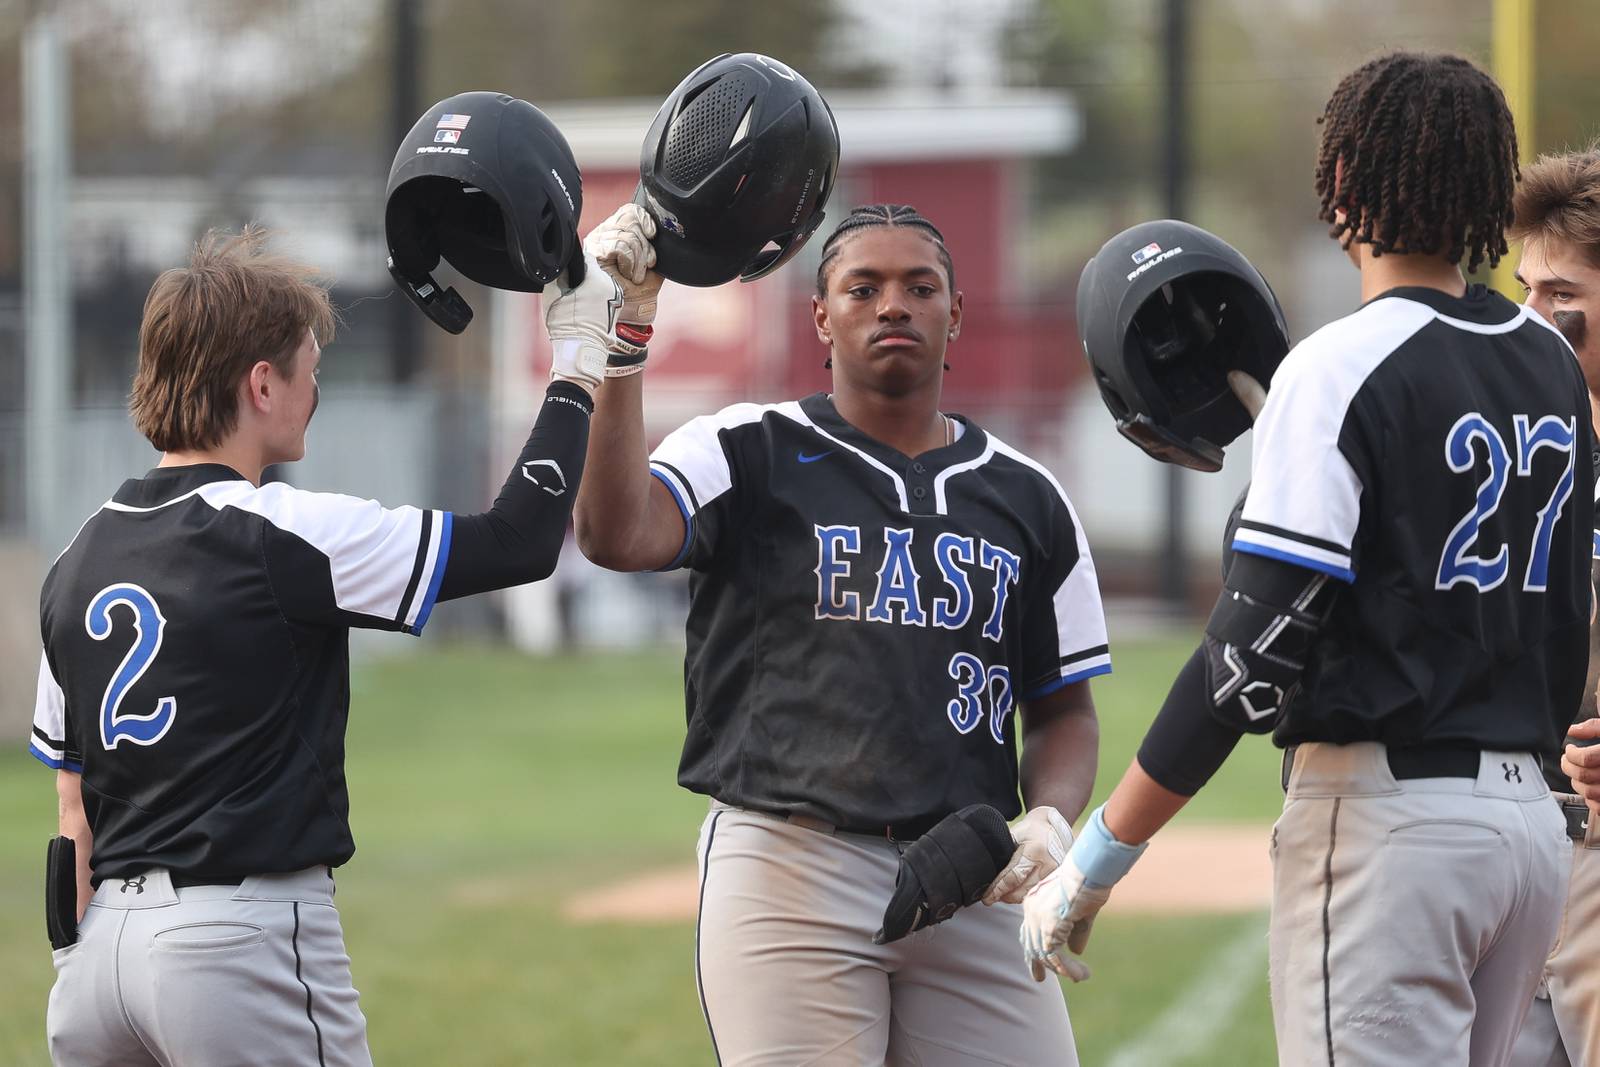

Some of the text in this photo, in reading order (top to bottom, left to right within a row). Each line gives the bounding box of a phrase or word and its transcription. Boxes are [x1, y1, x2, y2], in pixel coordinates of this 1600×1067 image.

[1435, 411, 1577, 594] 27
[813, 523, 1021, 643] EAST
[85, 582, 177, 751] 2
[947, 651, 1013, 745] 30
